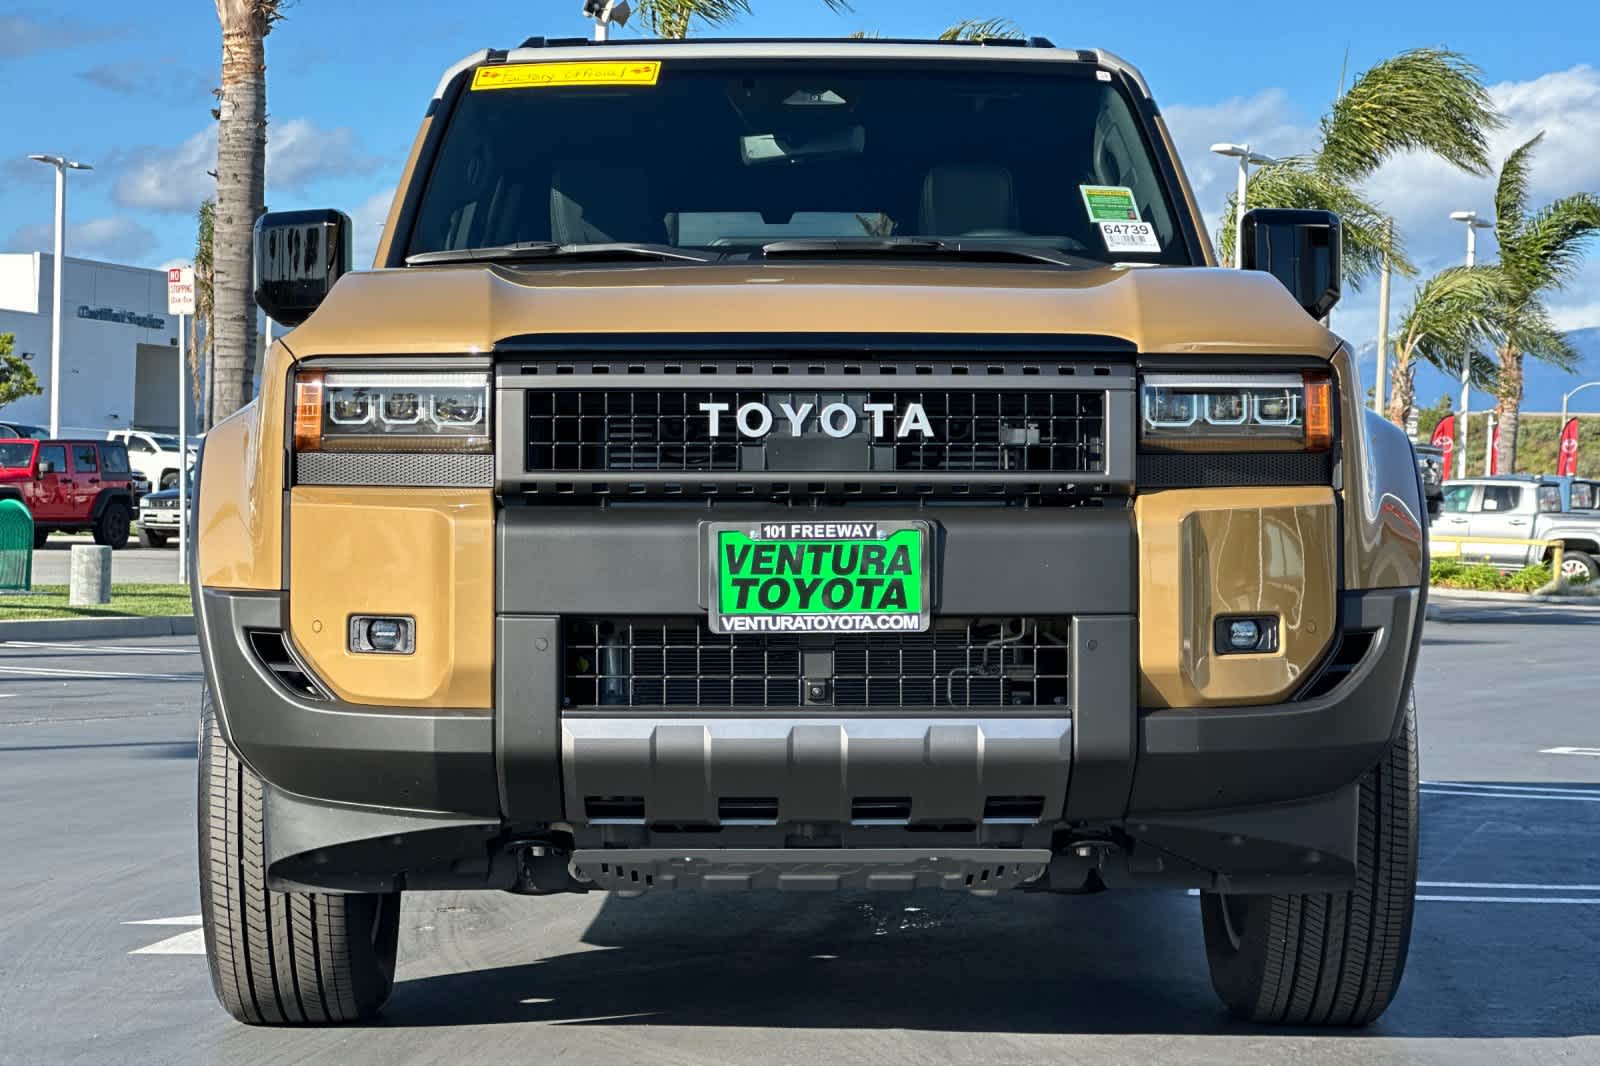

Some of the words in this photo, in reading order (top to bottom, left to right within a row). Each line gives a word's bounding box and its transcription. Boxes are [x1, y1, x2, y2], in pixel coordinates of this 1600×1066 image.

[1103, 224, 1149, 235] 64739
[170, 270, 180, 281] NO
[699, 402, 935, 438] TOYOTA
[764, 525, 786, 538] 101
[791, 524, 874, 538] FREEWAY
[725, 544, 913, 575] VENTURA
[731, 577, 908, 610] TOYOTA
[721, 615, 919, 631] VENTURATOYOTA.COM
